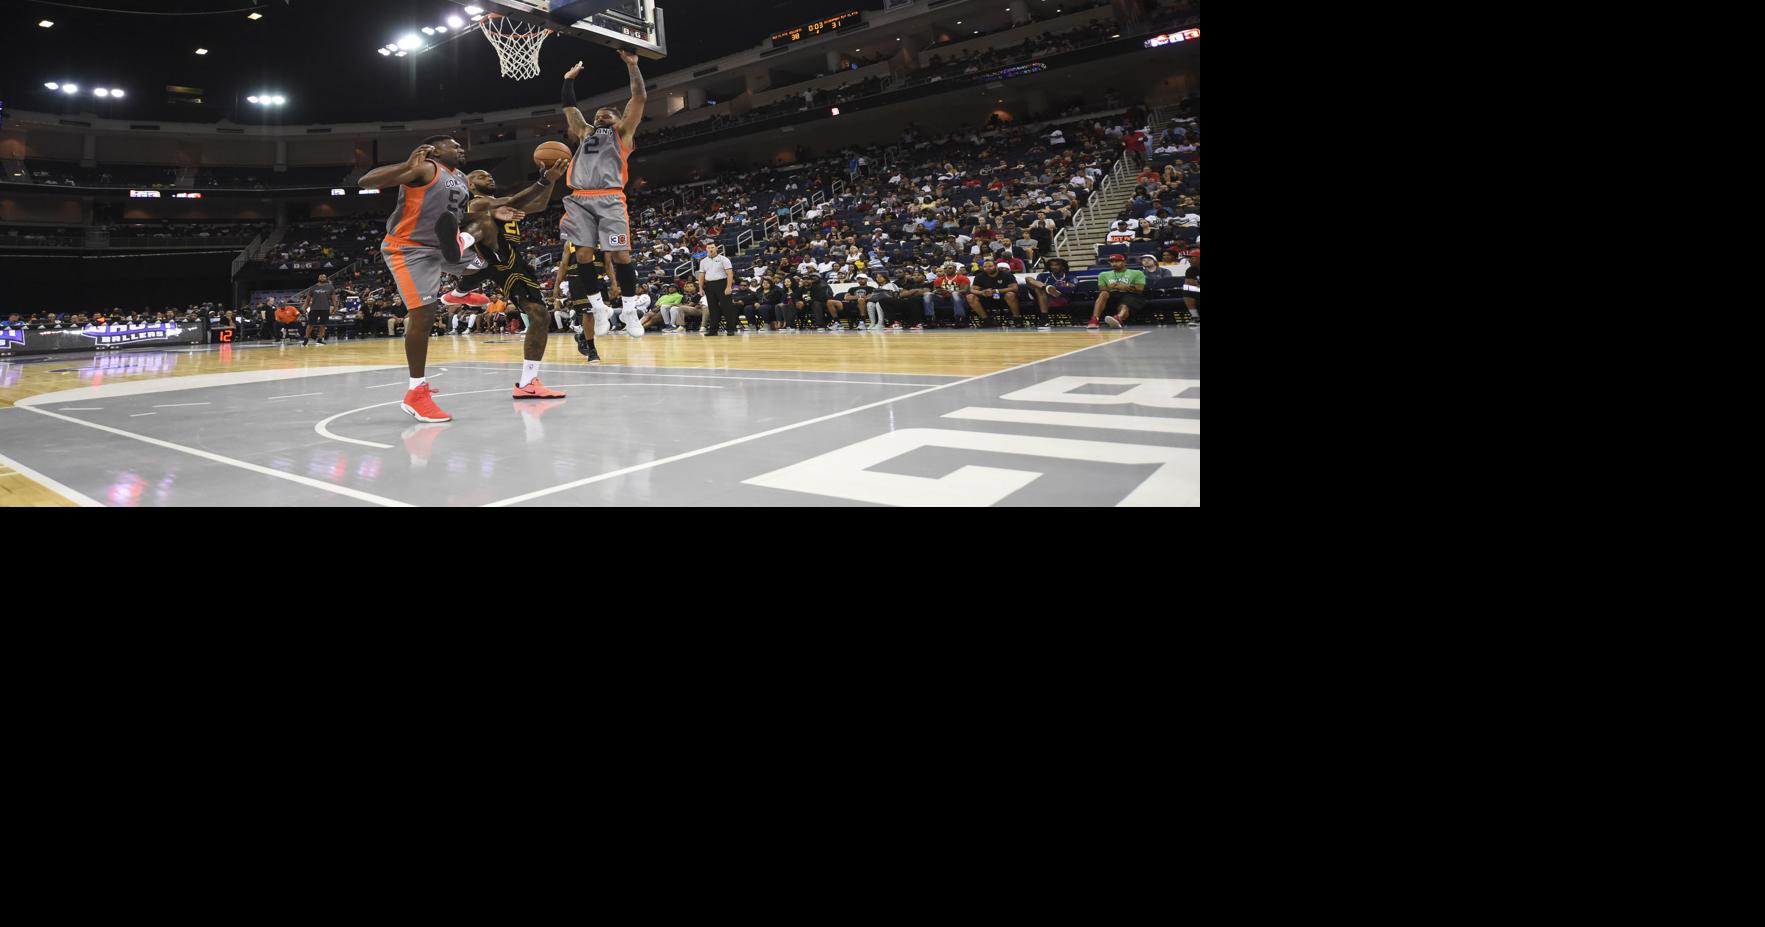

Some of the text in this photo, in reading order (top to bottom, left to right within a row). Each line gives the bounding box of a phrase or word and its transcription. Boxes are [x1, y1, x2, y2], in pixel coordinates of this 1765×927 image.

[583, 136, 600, 155] 2
[101, 331, 164, 343] BALLERS
[219, 330, 232, 342] 12
